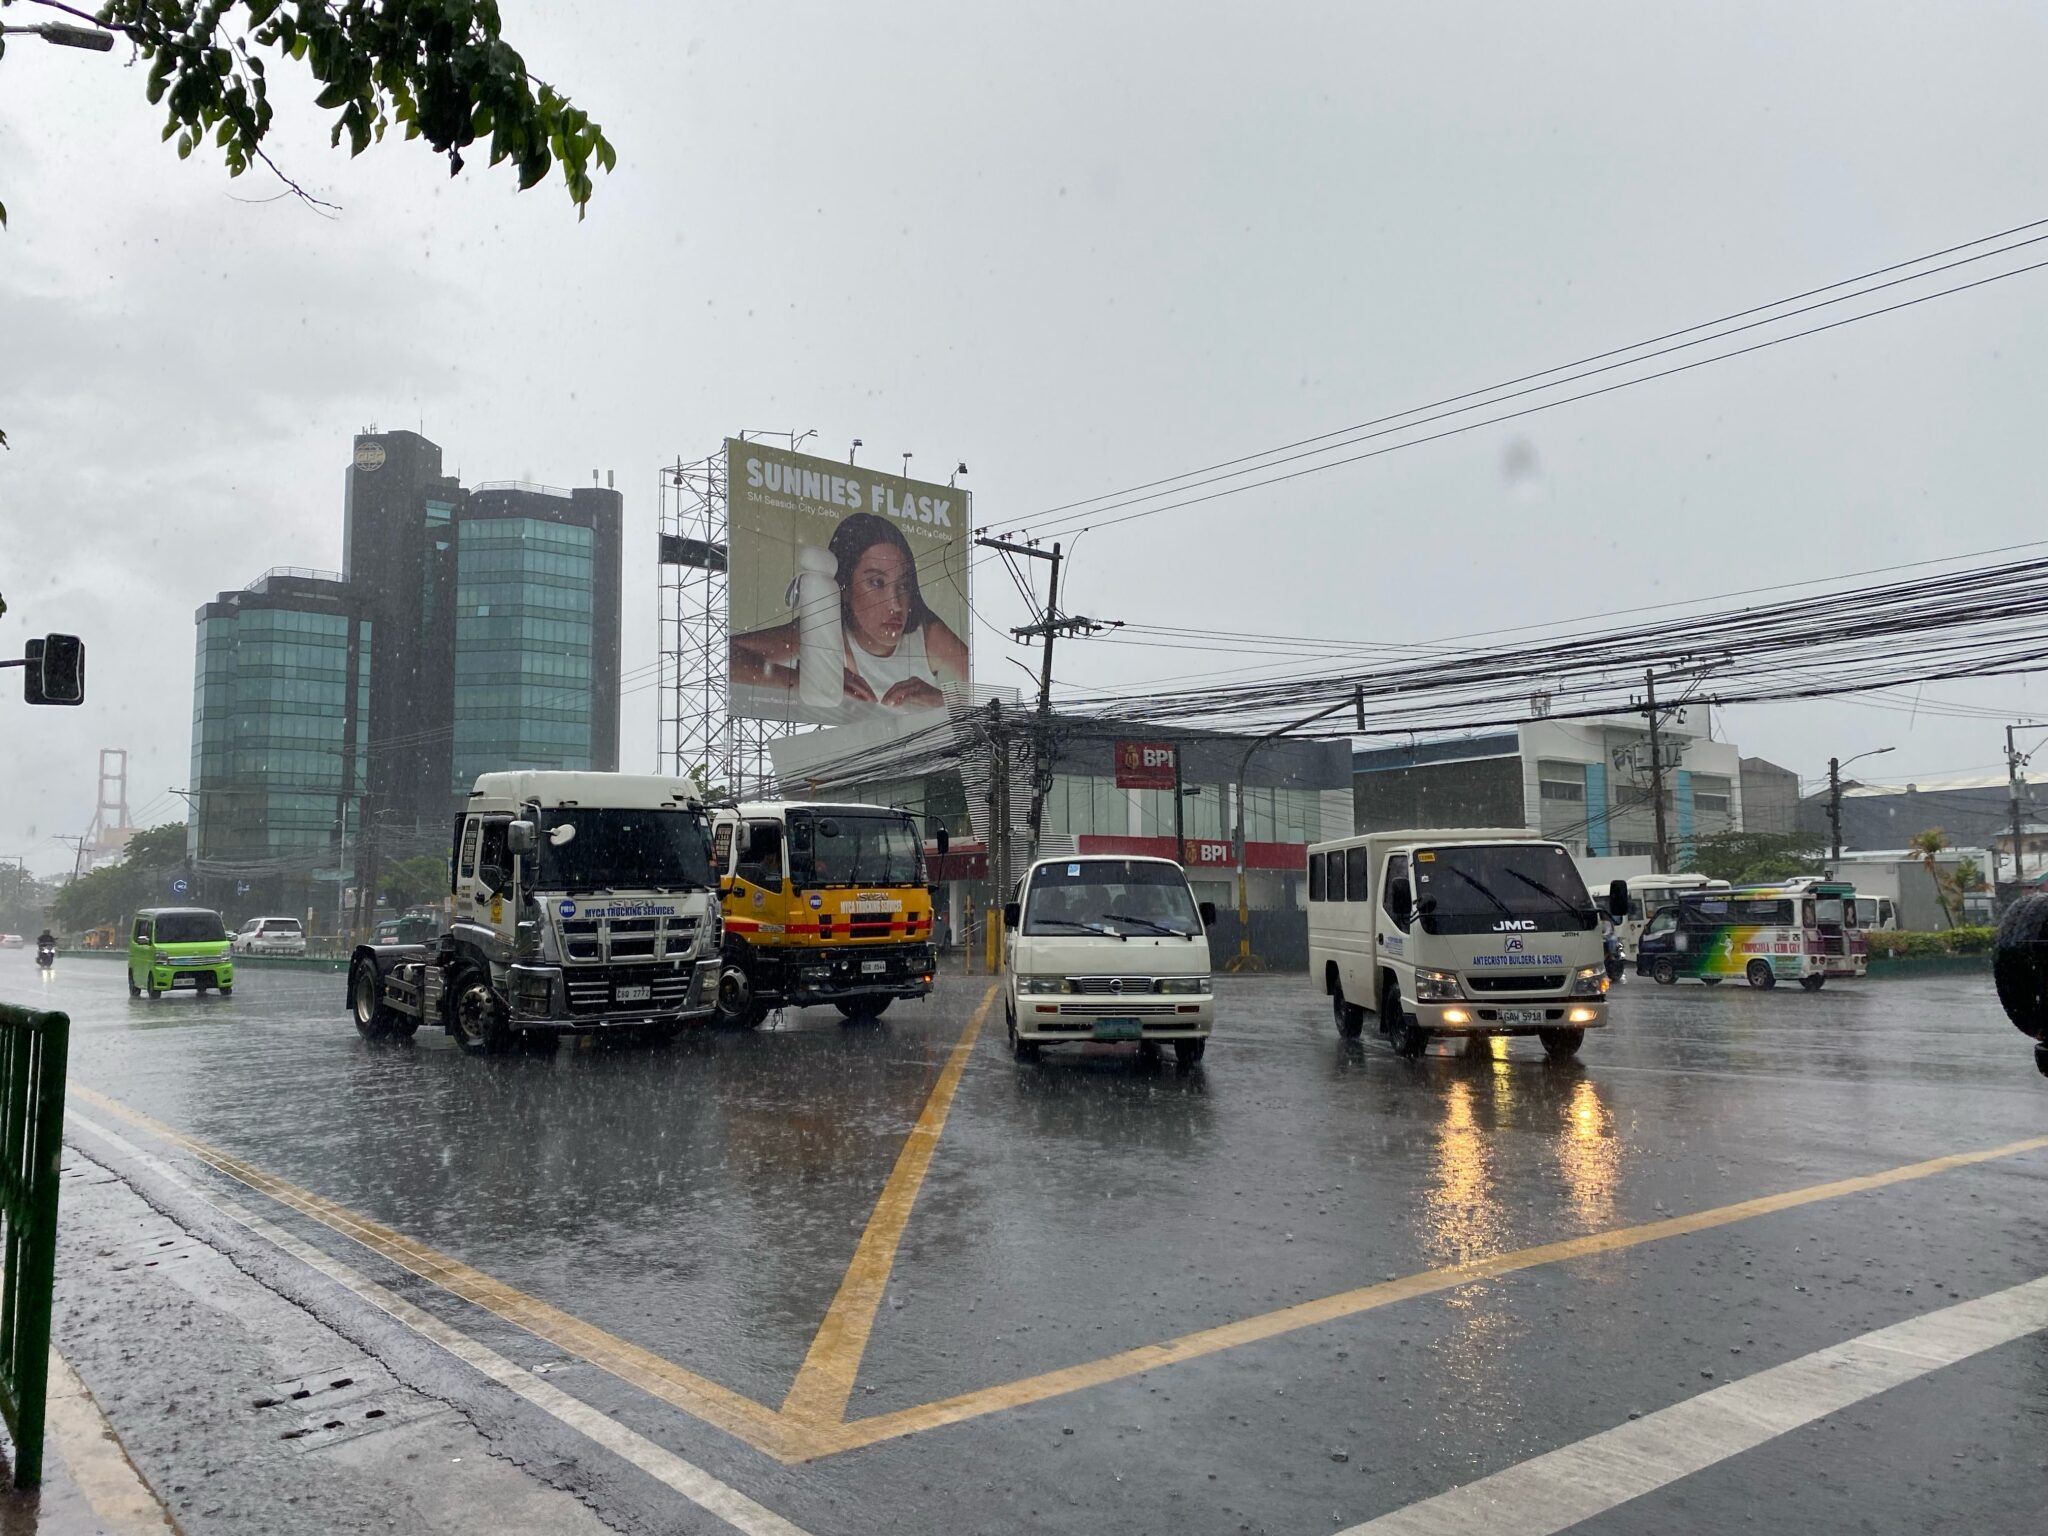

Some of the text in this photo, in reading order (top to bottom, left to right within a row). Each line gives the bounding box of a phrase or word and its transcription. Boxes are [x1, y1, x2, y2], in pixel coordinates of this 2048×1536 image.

[746, 458, 951, 527] SUNNIES FLASK
[747, 491, 839, 518] SM Seaside City Cebu
[901, 523, 952, 540] SM City Cebu
[1143, 749, 1174, 768] BPI
[1201, 844, 1227, 861] BPI
[585, 906, 675, 917] MYCA TRUCKING SERVICES
[1493, 920, 1536, 931] JMC
[1473, 955, 1507, 966] ANTECRISTO
[1509, 955, 1536, 965] BUILDERS
[1542, 954, 1563, 965] DESIGN
[1504, 1012, 1542, 1021] GAW 5918
